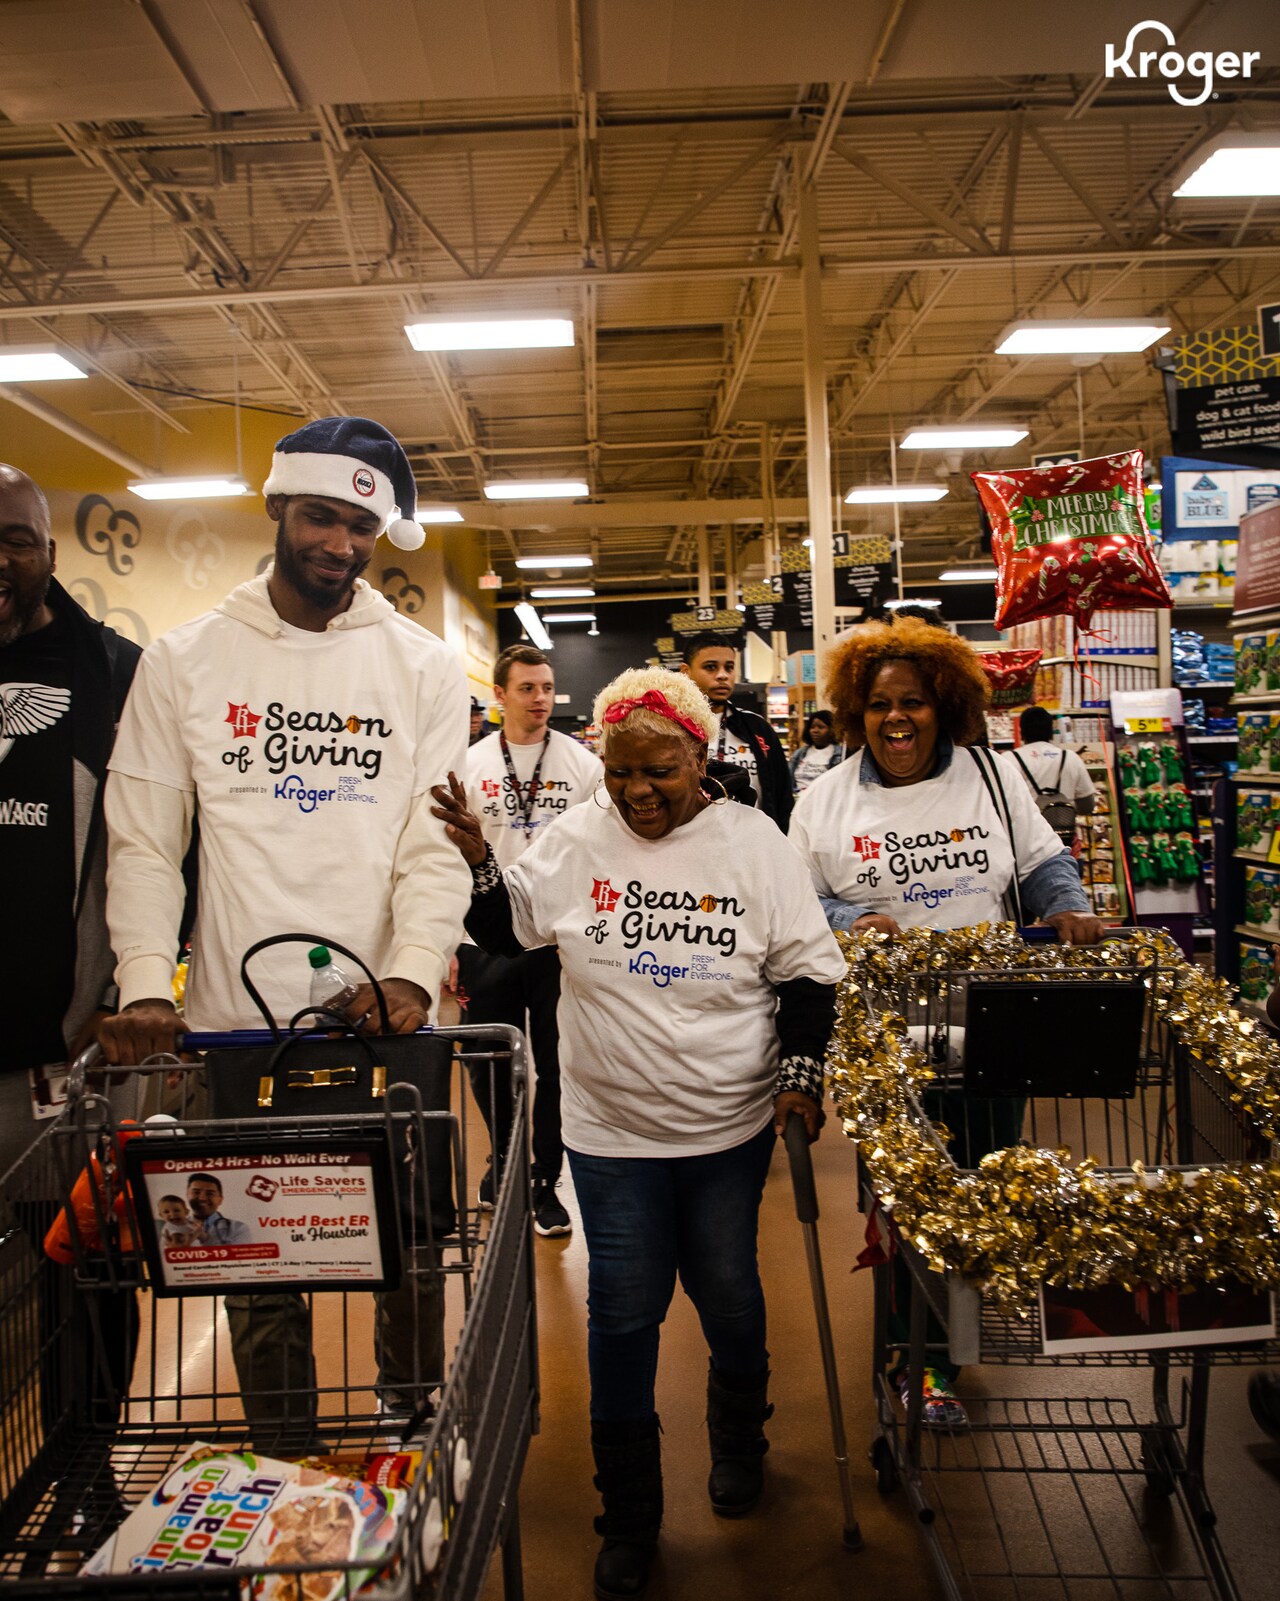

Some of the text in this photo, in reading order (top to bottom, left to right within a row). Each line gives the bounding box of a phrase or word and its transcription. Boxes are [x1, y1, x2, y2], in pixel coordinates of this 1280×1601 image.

[1215, 386, 1234, 399] pet
[1236, 384, 1261, 395] care
[1196, 410, 1219, 421] dog
[1233, 406, 1252, 416] cat
[1200, 429, 1226, 441] wild
[1227, 426, 1252, 438] bird
[1047, 492, 1109, 519] MERRY
[1186, 505, 1224, 517] BLUE
[697, 608, 715, 620] 23
[265, 702, 392, 738] Season
[264, 733, 382, 779] Giving
[337, 785, 355, 793] FOR
[338, 776, 362, 784] FRESH
[274, 774, 337, 813] Kroger
[884, 825, 989, 853] Season
[889, 848, 989, 885] Giving
[624, 880, 746, 917] Season
[903, 883, 954, 909] Kroger
[621, 911, 736, 957] Giving
[691, 954, 716, 963] FRESH
[691, 963, 708, 972] FOR
[628, 951, 690, 988] Kroger
[164, 1160, 203, 1172] Open
[205, 1158, 223, 1168] 24
[226, 1157, 251, 1167] Hrs
[261, 1155, 281, 1165] No
[284, 1154, 316, 1164] Wait
[319, 1153, 350, 1163] Ever
[280, 1176, 365, 1187] Life Savers
[258, 1215, 370, 1227] Voted Best ER
[291, 1227, 368, 1242] in Houston
[168, 1249, 228, 1260] COVID-19
[132, 1468, 226, 1570] innamon
[168, 1489, 241, 1563] Toast
[195, 1478, 282, 1570] runch
